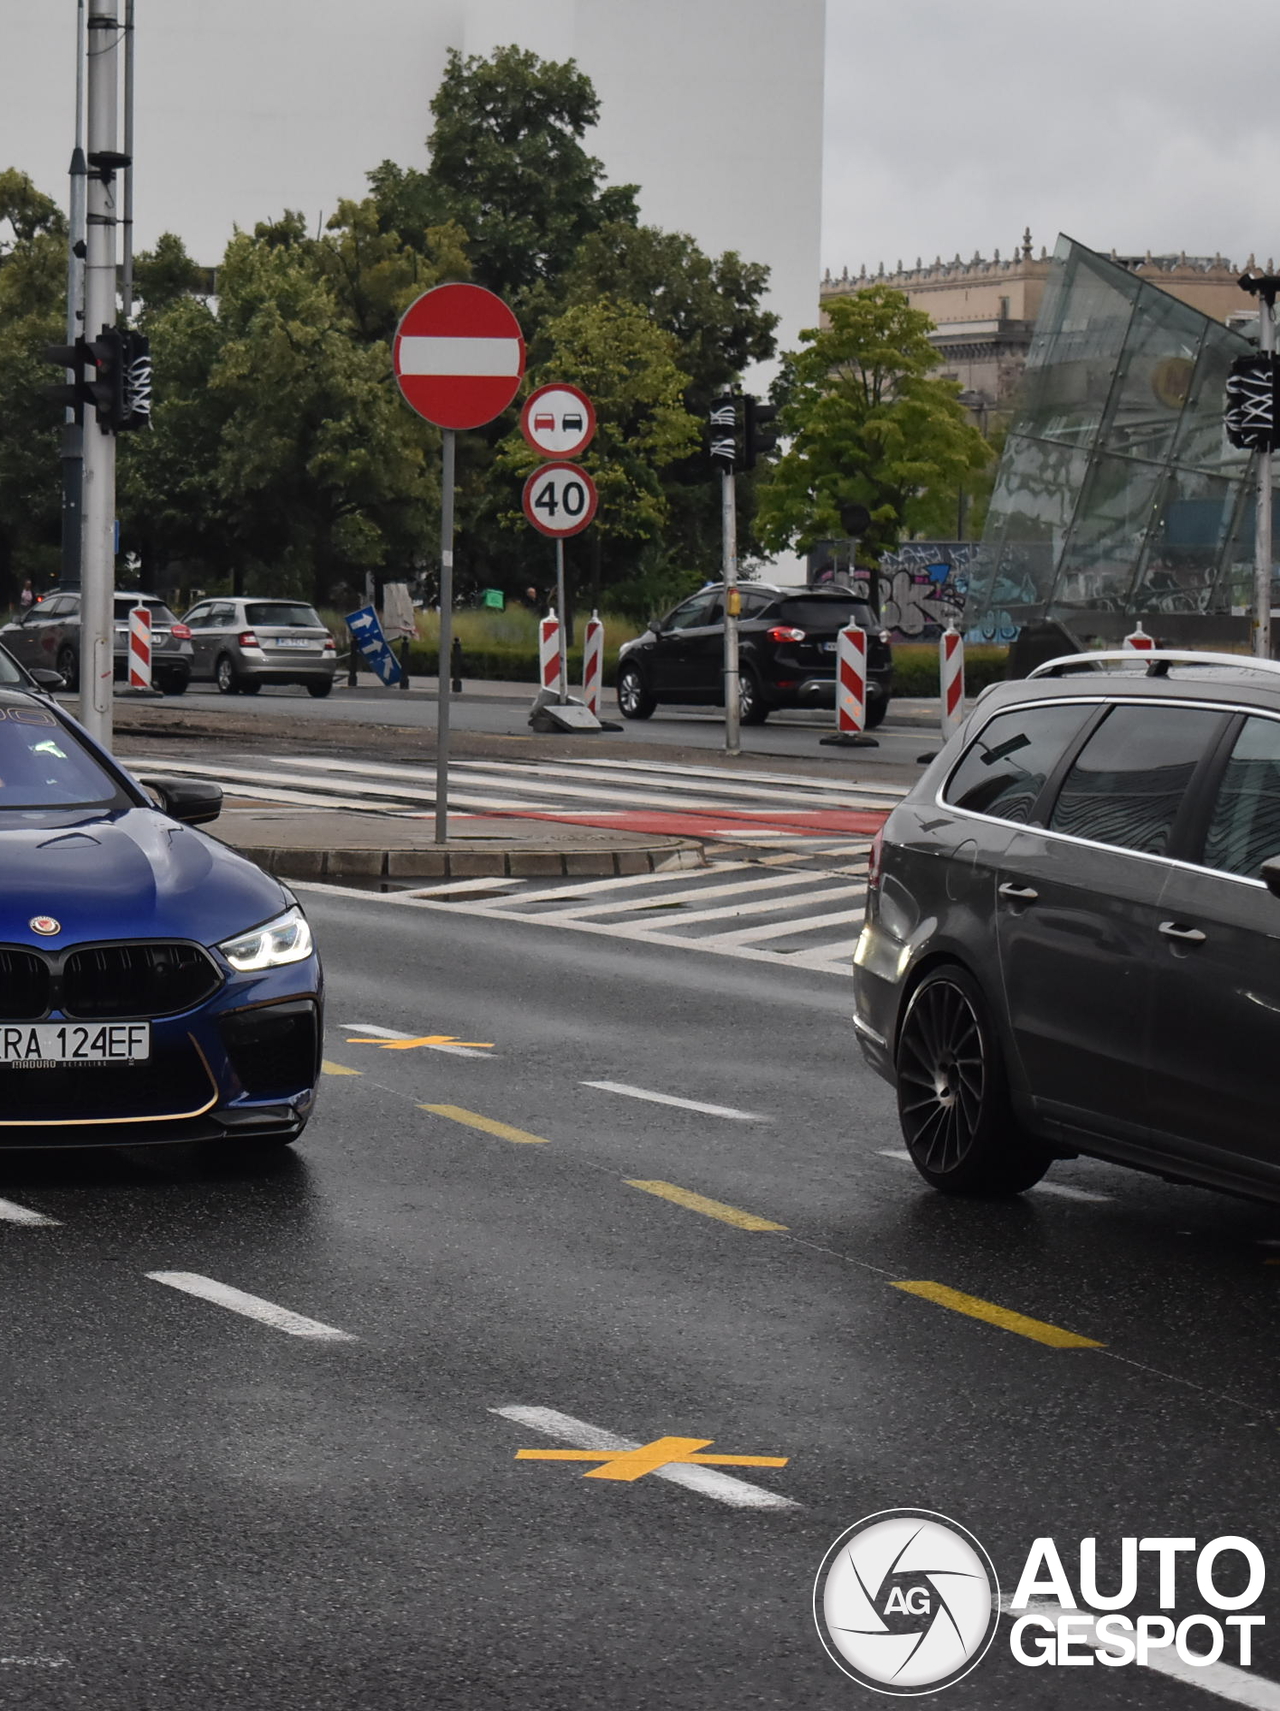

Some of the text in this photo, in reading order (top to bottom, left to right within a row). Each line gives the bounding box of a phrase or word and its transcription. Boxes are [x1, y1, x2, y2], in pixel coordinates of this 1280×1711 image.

[535, 481, 585, 517] 40
[57, 1026, 146, 1058] 124EF
[12, 1059, 57, 1069] MADURO
